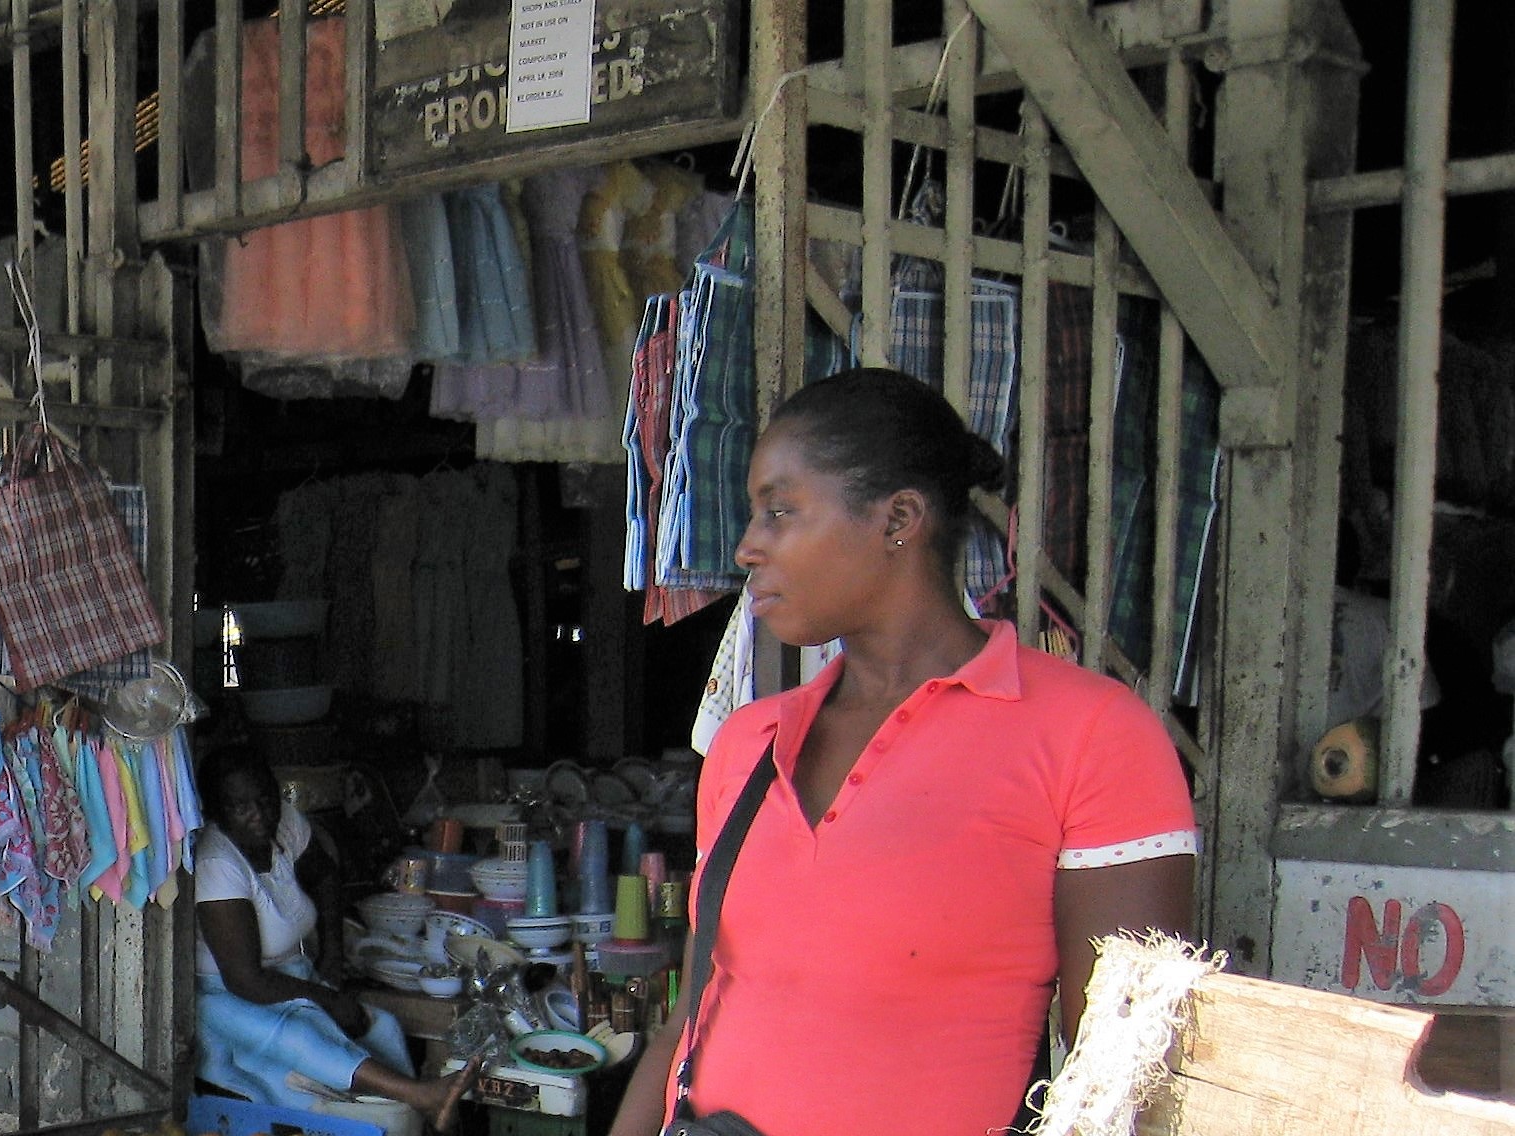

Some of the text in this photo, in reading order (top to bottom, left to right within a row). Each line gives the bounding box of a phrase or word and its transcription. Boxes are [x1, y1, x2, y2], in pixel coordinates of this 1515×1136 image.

[521, 22, 534, 30] NOT
[520, 38, 546, 47] MARKET
[519, 53, 557, 65] COMPOUND
[1341, 895, 1466, 997] NO
